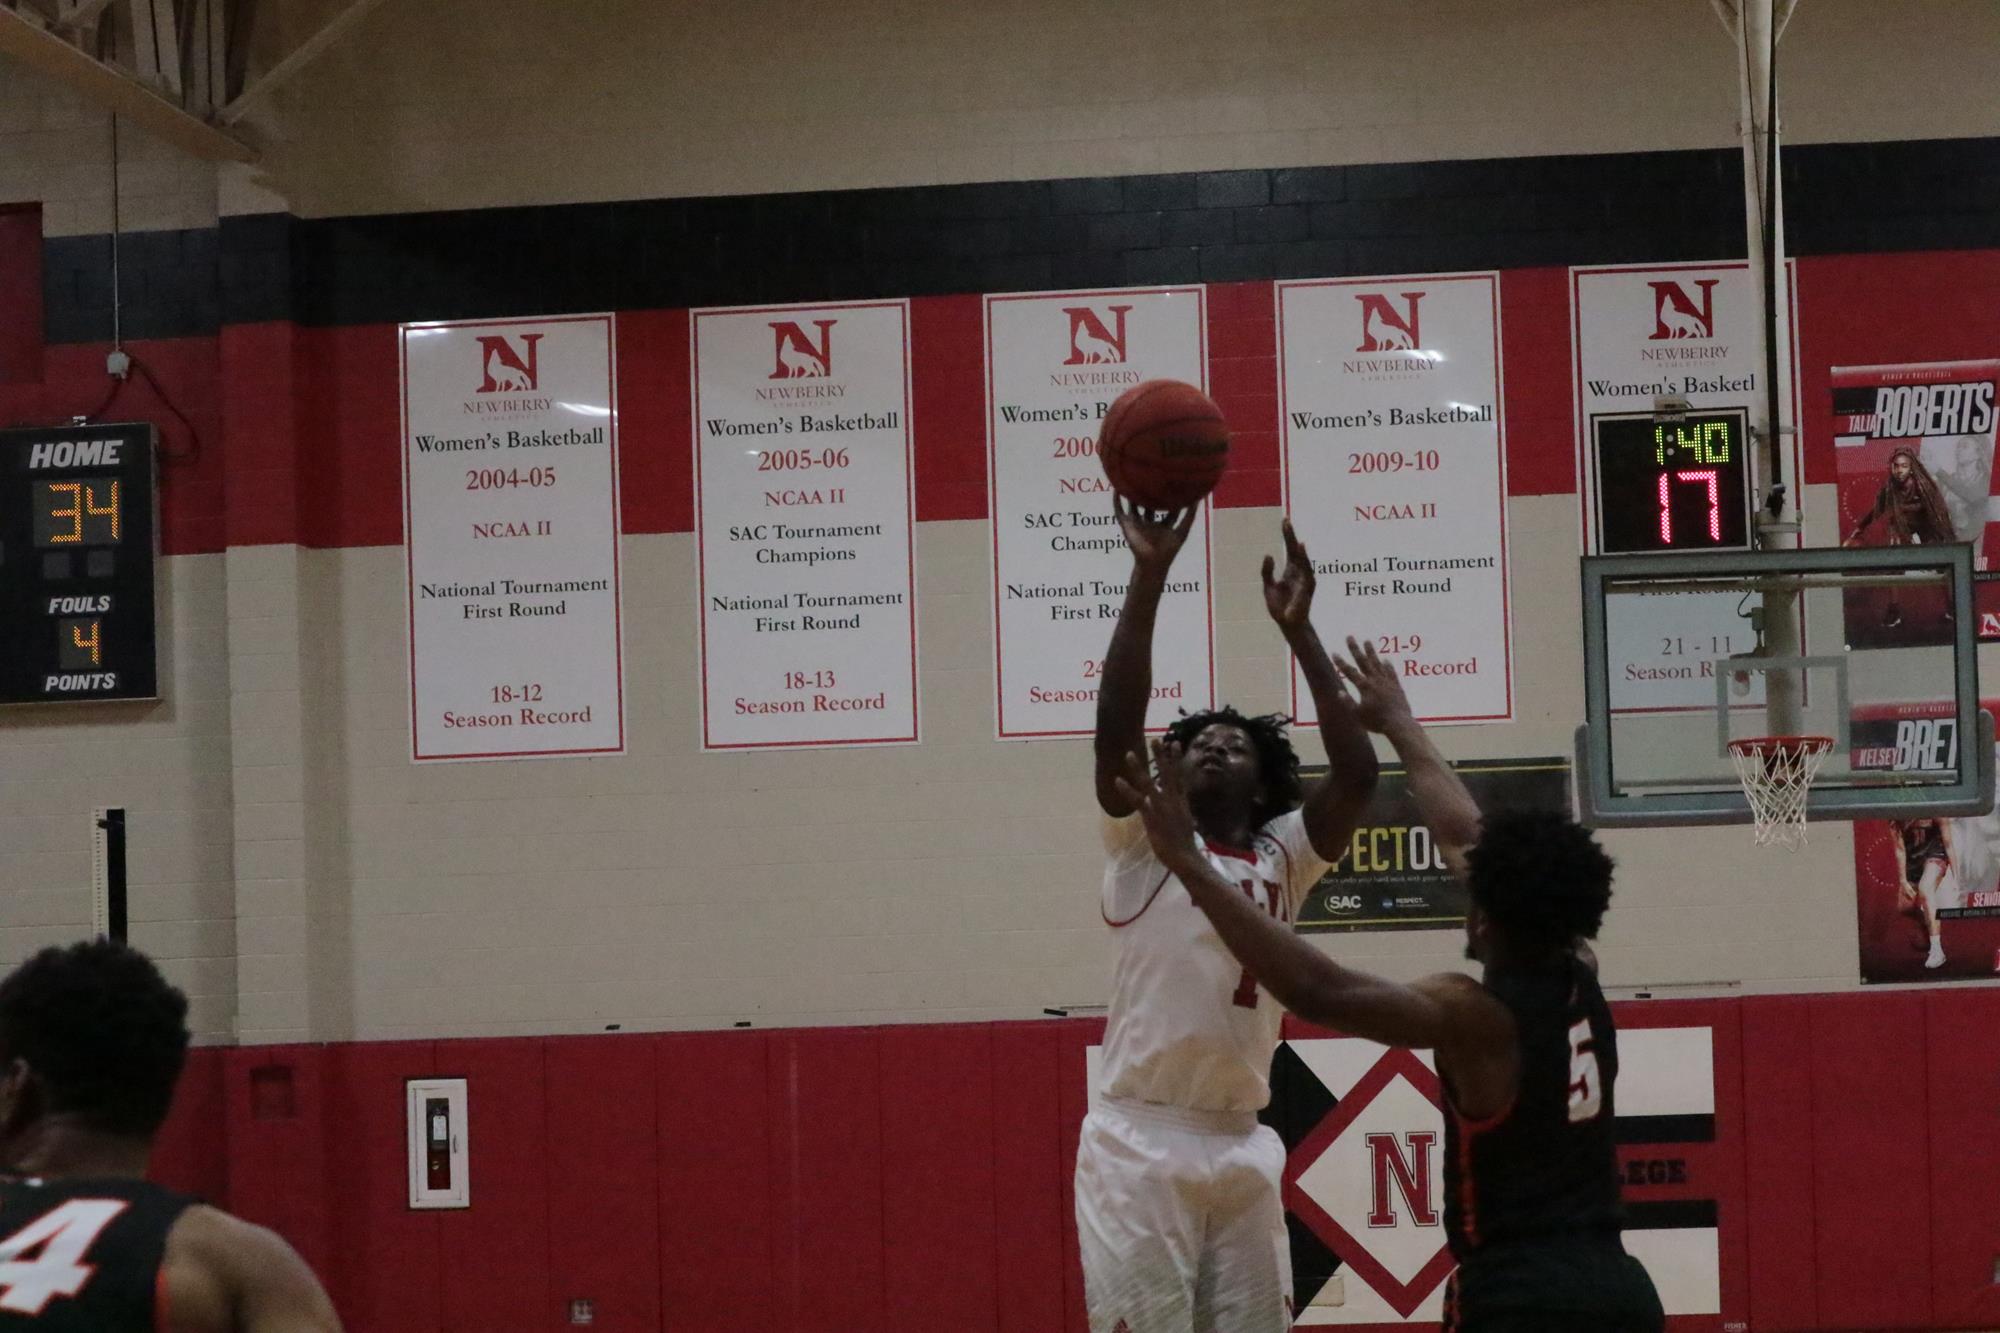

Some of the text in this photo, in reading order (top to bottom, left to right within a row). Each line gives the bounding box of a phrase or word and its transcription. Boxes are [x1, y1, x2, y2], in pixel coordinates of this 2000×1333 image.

[1641, 345, 1729, 361] NEWBERRY
[1343, 358, 1436, 375] NEWBERRY
[1050, 370, 1142, 387] NEWBERRY
[1588, 374, 1755, 398] Women's Basket
[755, 384, 846, 401] NEWBERRY
[463, 398, 553, 415] NEWBERRY
[1000, 402, 1088, 425] Women's
[1872, 381, 1994, 438] ROBERTS
[707, 412, 898, 437] Women's Basketball
[1291, 405, 1492, 430] Women's Basketball
[1849, 414, 1878, 433] TALIA
[416, 428, 604, 453] Women's Basketball
[1655, 422, 1730, 465] 1:40
[29, 439, 124, 469] HOME
[757, 448, 849, 472] 2005-06
[1348, 450, 1440, 474] 2009-10
[466, 467, 556, 490] 2004-05
[765, 488, 845, 507] NCAA II
[1658, 470, 1720, 544] 17
[49, 481, 119, 542] 34
[1024, 512, 1062, 529] SAC
[1354, 503, 1436, 522] NCAA II
[473, 521, 552, 539] NCAA II
[729, 522, 881, 542] SAC Tournament
[756, 546, 856, 567] Champions
[1383, 556, 1495, 572] Tournament
[421, 577, 608, 599] National Tournament
[1007, 582, 1085, 600] National
[1345, 578, 1451, 596] First Round
[49, 596, 111, 614] FOULS
[463, 600, 566, 620] First Round
[712, 591, 903, 612] National Tournament
[1051, 604, 1092, 621] First
[756, 614, 860, 633] First Round
[73, 622, 99, 665] 4
[1378, 634, 1422, 654] 21-9
[1662, 637, 1683, 655] 21
[1712, 636, 1731, 653] 11
[1404, 657, 1477, 676] Record
[1625, 663, 1692, 681] Season
[45, 672, 116, 692] POINTS
[783, 671, 836, 690] 18-13
[490, 684, 543, 704] 18-12
[735, 693, 885, 715] Season Record
[443, 706, 592, 728] Season Record
[1859, 748, 1899, 767] KELSEY
[1329, 895, 1362, 910] SAC
[1365, 1131, 1438, 1229] N
[0, 1199, 131, 1316] 4
